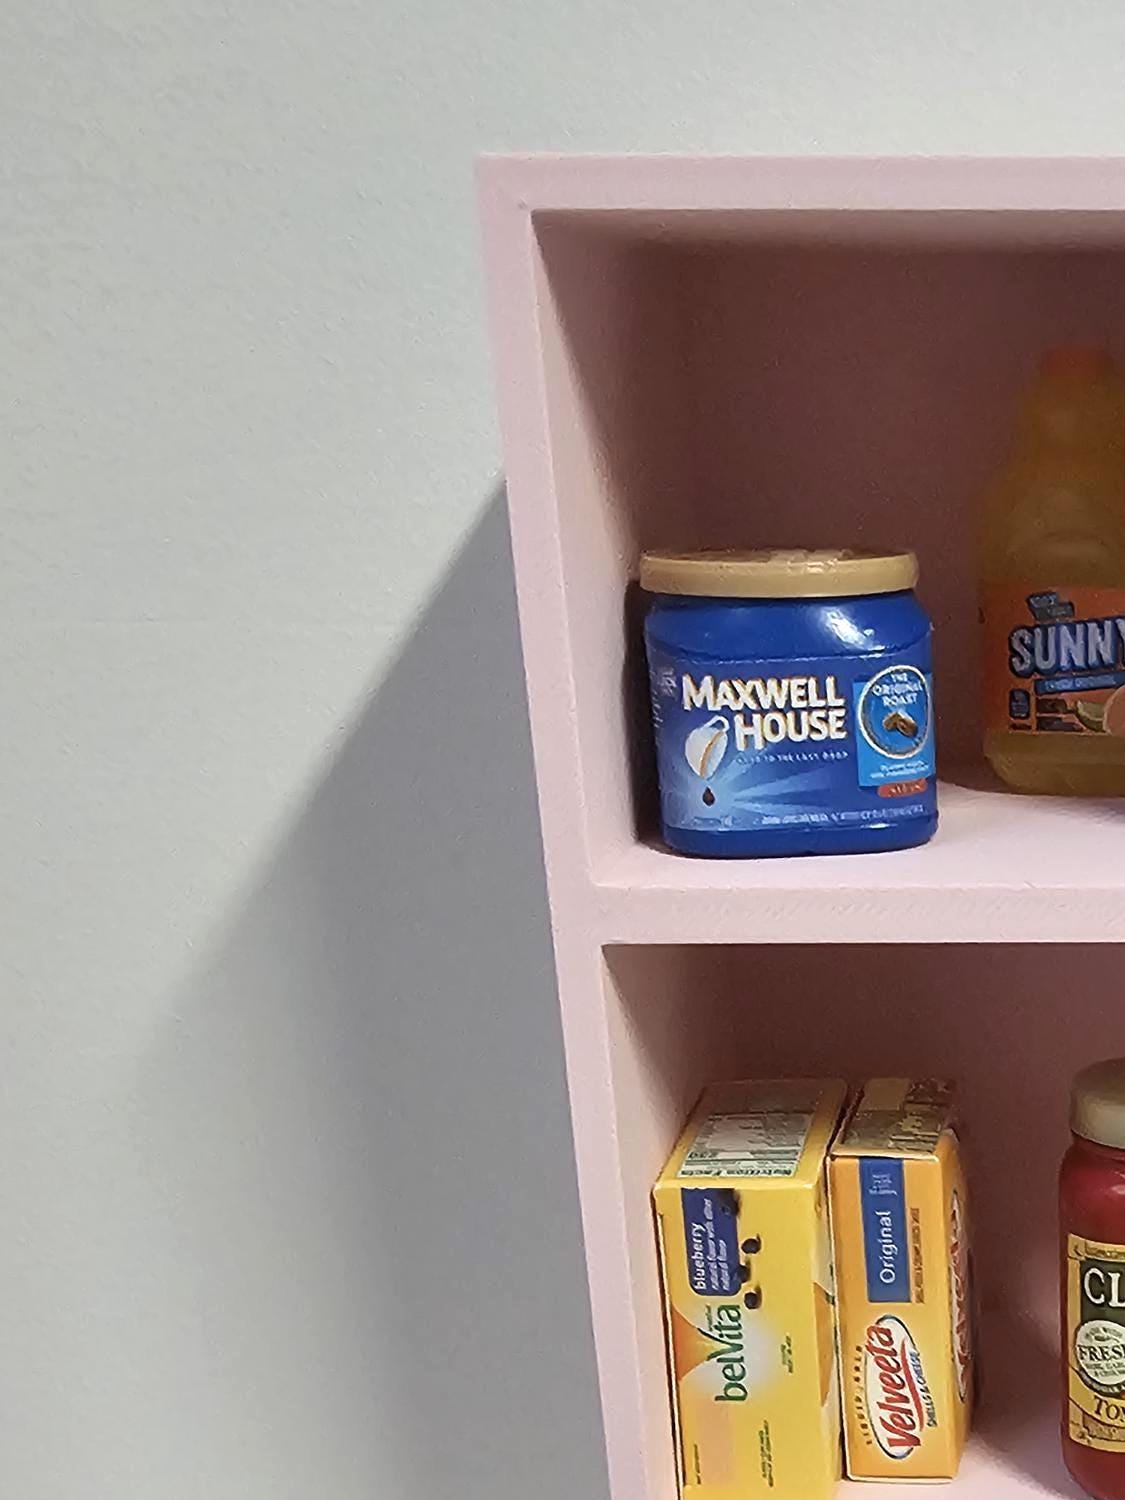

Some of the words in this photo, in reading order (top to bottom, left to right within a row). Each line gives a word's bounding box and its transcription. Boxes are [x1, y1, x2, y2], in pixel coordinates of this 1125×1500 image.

[682, 672, 846, 712] MAXWELL
[733, 708, 848, 751] HOUSE
[691, 1222, 707, 1290] blueberry
[874, 1210, 899, 1284] Original
[697, 1303, 748, 1402] belVita
[864, 1323, 922, 1448] Velveeta
